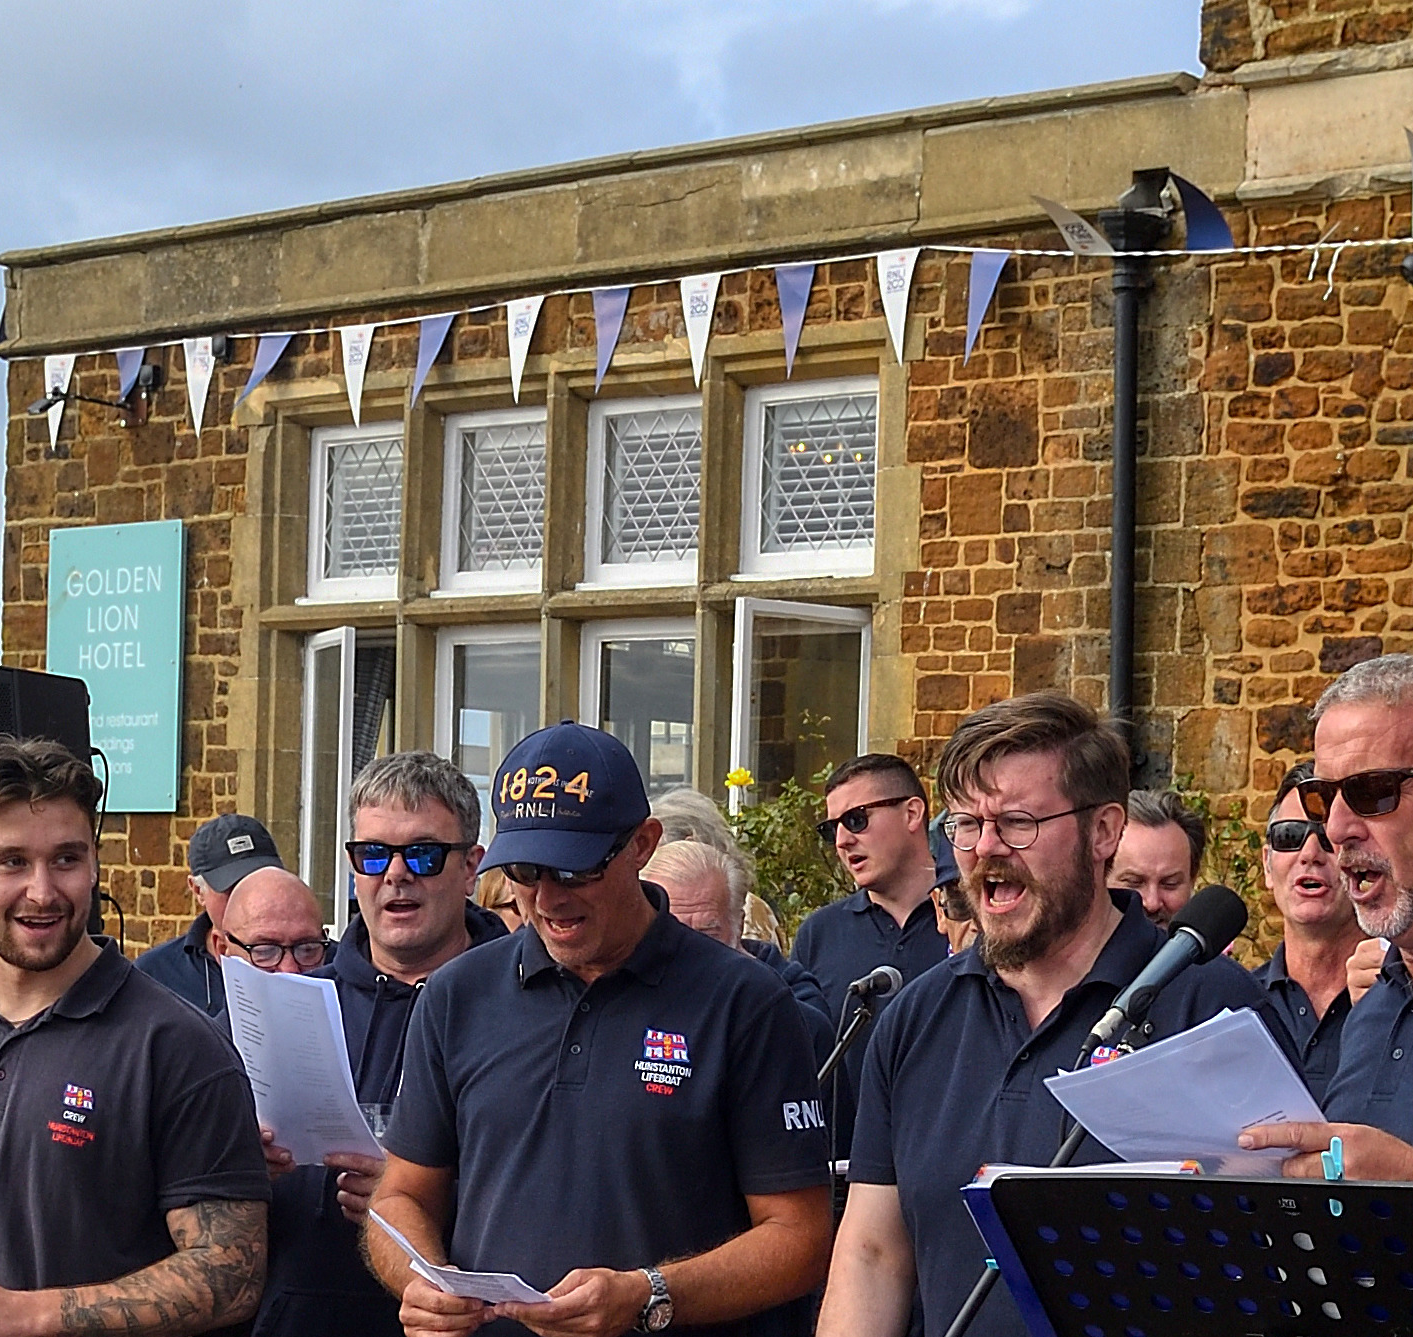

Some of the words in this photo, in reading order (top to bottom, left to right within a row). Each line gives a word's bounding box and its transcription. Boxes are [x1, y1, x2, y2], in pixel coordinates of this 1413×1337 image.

[67, 565, 162, 597] GOLDEN
[87, 604, 139, 634] LION
[79, 642, 146, 670] HOTEL
[106, 711, 159, 728] restaurant
[499, 766, 589, 804] 1824
[515, 802, 556, 819] RNLI
[634, 1060, 692, 1077] HUNSTANTON
[641, 1071, 683, 1086] LIFEBOAT
[645, 1082, 674, 1095] CREW
[63, 1110, 87, 1123] CREW
